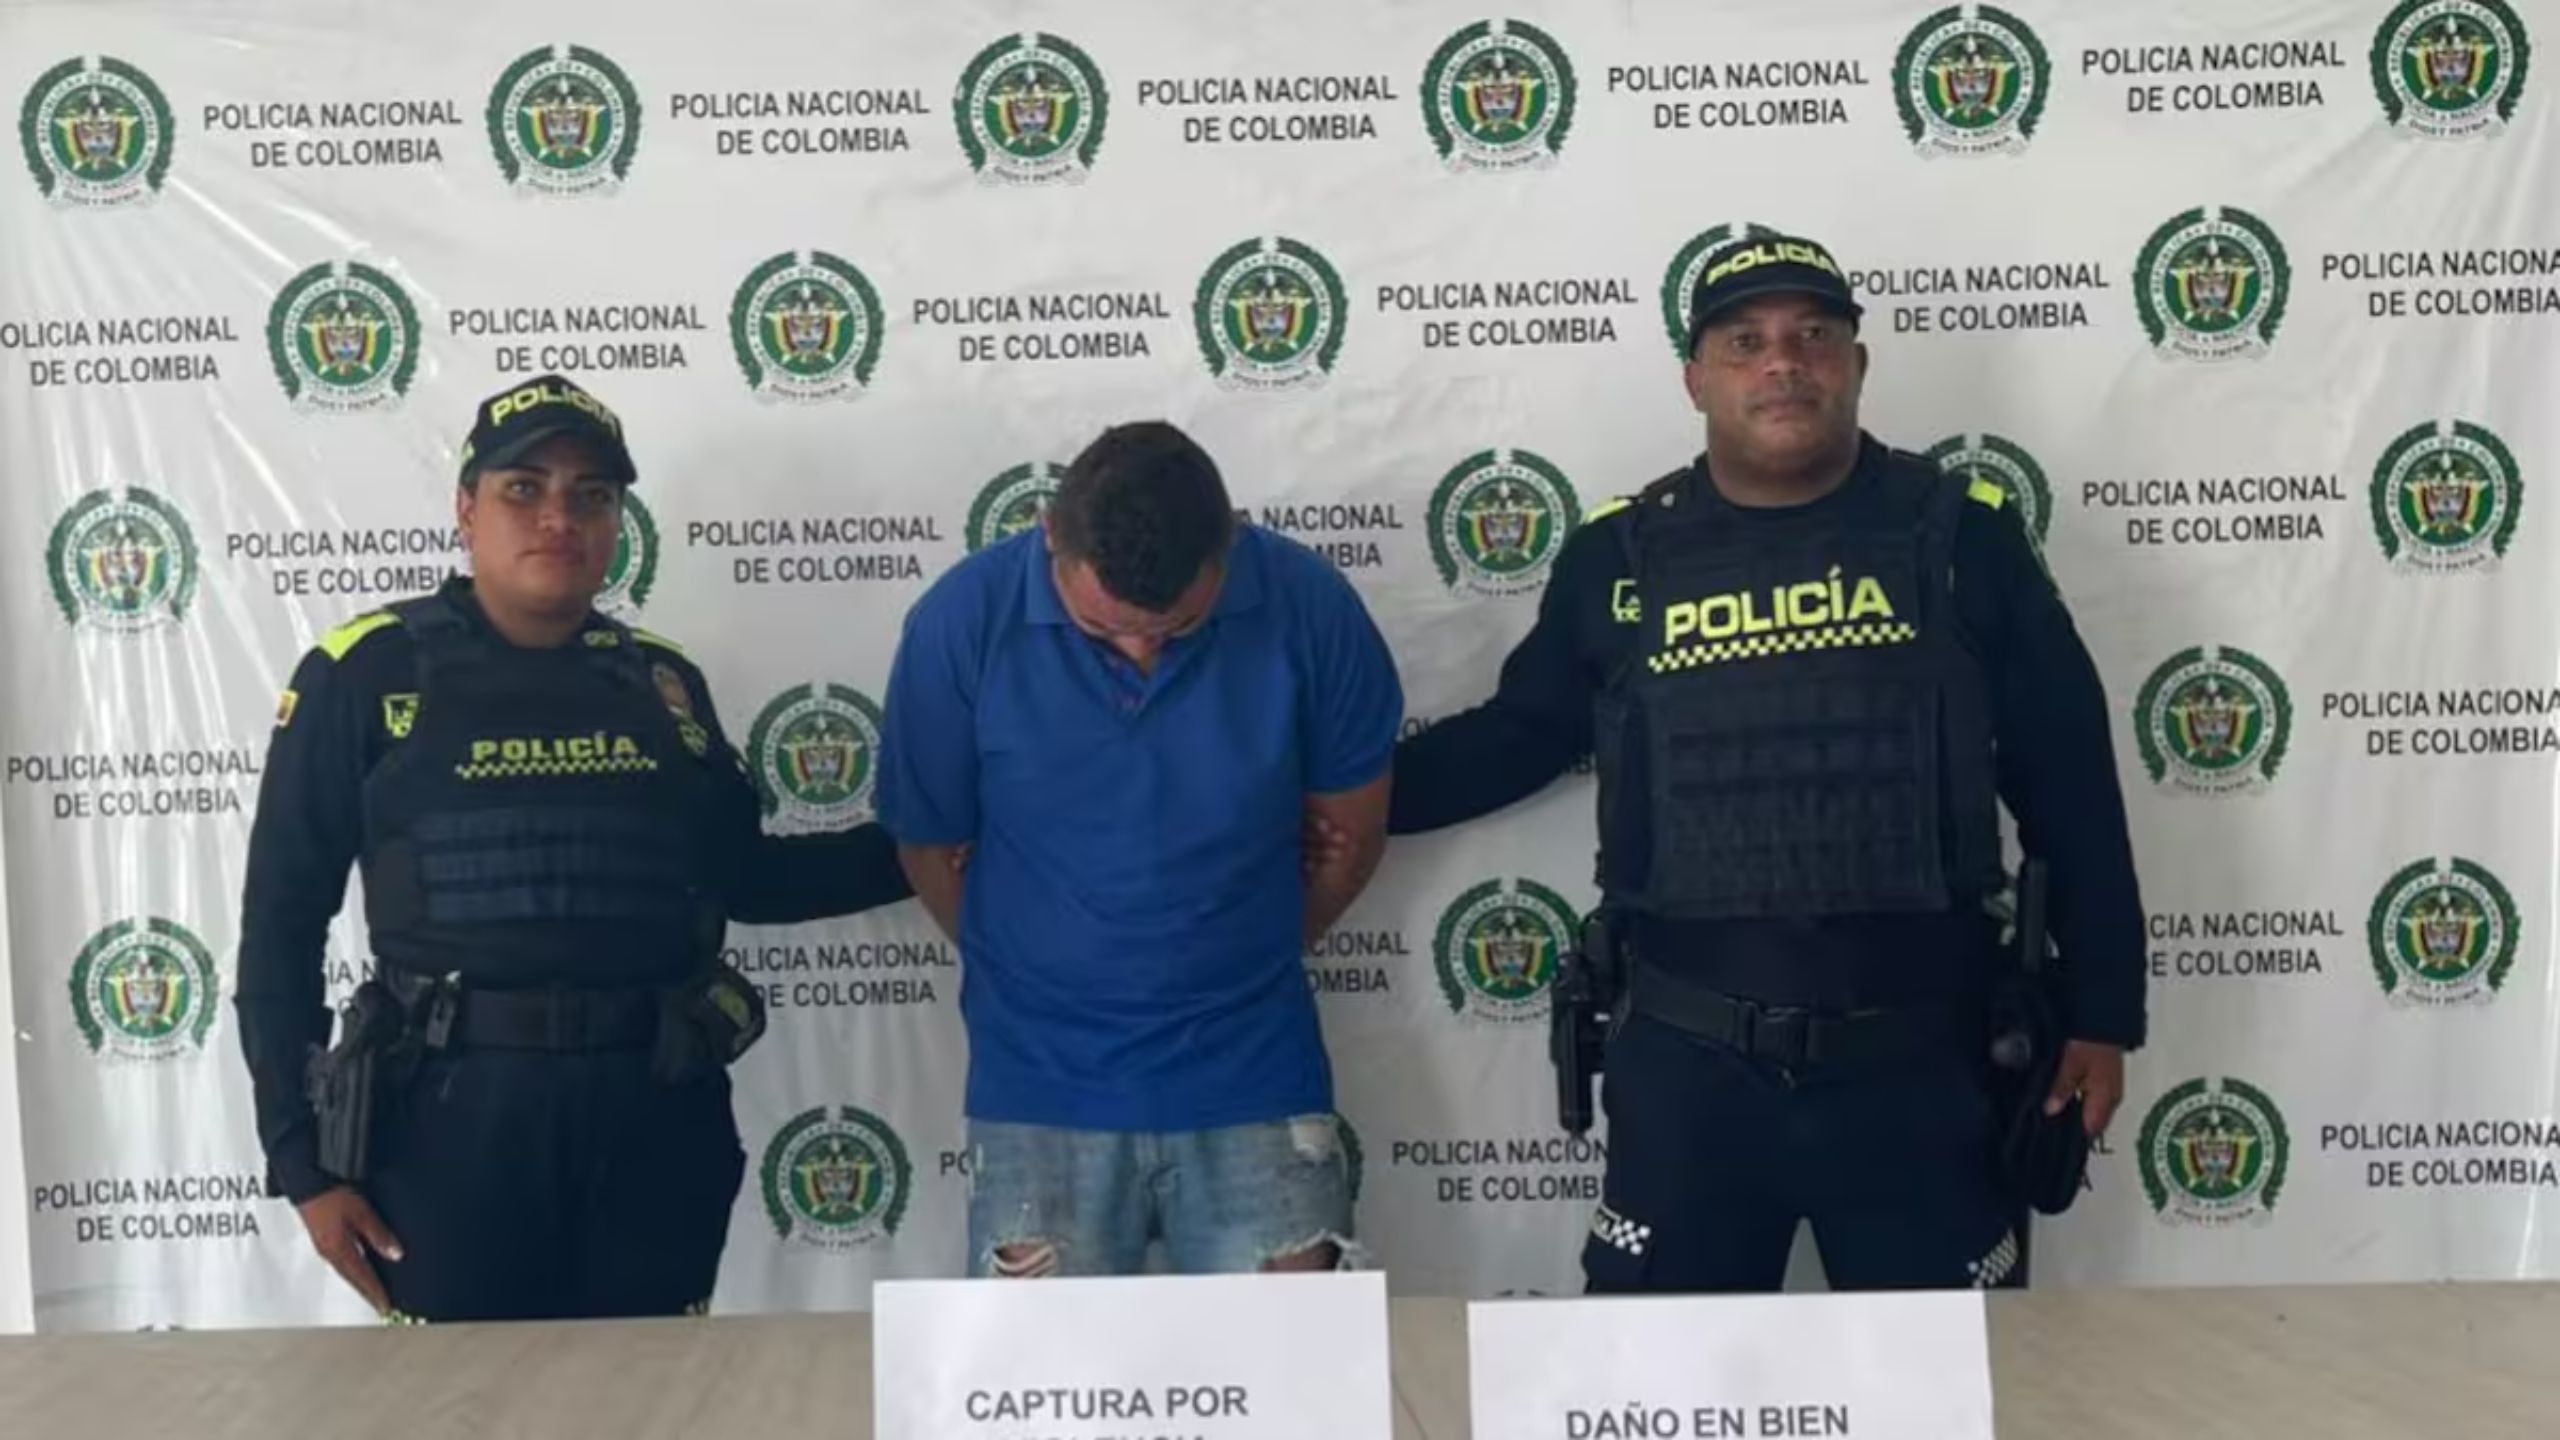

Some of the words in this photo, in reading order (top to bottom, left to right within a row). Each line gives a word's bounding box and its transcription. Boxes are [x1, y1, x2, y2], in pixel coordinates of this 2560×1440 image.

[2082, 46, 2193, 75] POLICIA
[2201, 41, 2346, 71] NACIONAL
[1138, 78, 1248, 106] POLICIA
[1255, 76, 1398, 103] NACIONAL
[1608, 64, 1719, 92] POLICIA
[1725, 60, 1869, 89] NACIONAL
[671, 92, 780, 119] POLICIA
[787, 89, 930, 117] NACIONAL
[2128, 85, 2164, 113] DE
[2172, 80, 2324, 111] COLOMBIA
[204, 104, 314, 130] POLICIA
[320, 100, 462, 128] NACIONAL
[1184, 116, 1221, 143] DE
[1229, 113, 1377, 142] COLOMBIA
[1654, 102, 1691, 129] DE
[1699, 98, 1848, 128] COLOMBIA
[251, 141, 288, 167] DE
[296, 138, 443, 166] COLOMBIA
[717, 129, 753, 155] DE
[761, 127, 909, 154] COLOMBIA
[1849, 268, 1959, 295] POLICIA
[1966, 263, 2110, 292] NACIONAL
[2322, 251, 2435, 280] POLICIA
[2442, 249, 2560, 277] NACIONA
[913, 296, 1022, 324] POLICIA
[1029, 293, 1170, 321] NACIONAL
[1378, 283, 1488, 311] POLICIA
[1495, 278, 1638, 307] NACIONAL
[2369, 290, 2406, 317] DE
[2415, 286, 2560, 316] COLOMBIA
[0, 321, 91, 348] OLICIA
[98, 317, 238, 345] NACIONAL
[449, 308, 559, 335] POLICIA
[565, 305, 706, 332] NACIONAL
[1424, 321, 1460, 348] DE
[1468, 316, 1617, 346] COLOMBIA
[1894, 307, 1930, 333] DE
[1939, 301, 2088, 331] COLOMBIA
[496, 346, 533, 372] DE
[540, 343, 687, 372] COLOMBIA
[960, 335, 996, 362] DE
[1003, 331, 1150, 361] COLOMBIA
[30, 360, 66, 386] DE
[74, 354, 219, 384] COLOMBIA
[2083, 480, 2191, 507] POLICIA
[2198, 474, 2346, 505] NACIONAL
[688, 520, 795, 546] POLICIA
[803, 517, 942, 544] NACIONAL
[1263, 504, 1403, 531] NACIONAL
[2128, 518, 2163, 544] DE
[2172, 513, 2324, 543] COLOMBIA
[226, 530, 336, 559] POLICIA
[342, 527, 465, 556] NACIONA
[273, 569, 310, 596] DE
[734, 558, 769, 583] DE
[778, 555, 922, 582] COLOMBIA
[1664, 564, 1895, 647] POLICÍA
[2323, 691, 2430, 718] POLICIA
[2438, 688, 2560, 716] NACIONA
[471, 730, 638, 761] POLICÍA
[2367, 729, 2403, 756] DE
[2411, 726, 2560, 754] COLOMBIA
[8, 754, 116, 783] POLICIA
[122, 748, 259, 781] NACIONAL
[54, 793, 90, 818] DE
[98, 786, 241, 817] COLOMBIA
[2203, 911, 2344, 938] NACIONAL
[722, 946, 812, 973] OLICIA
[818, 943, 956, 970] NACIONAL
[2151, 951, 2168, 977] E
[2176, 948, 2322, 976] COLOMBIA
[793, 980, 936, 1007] COLOMBIA
[1304, 968, 1389, 993] OMBIA
[2321, 1123, 2430, 1150] POLICIA
[2436, 1121, 2560, 1149] NACIONA
[1394, 1141, 1500, 1165] POLICIA
[1507, 1138, 1608, 1164] NACION
[1438, 1177, 1472, 1201] DE
[1482, 1175, 1599, 1201] COLOMB
[2368, 1161, 2404, 1187] DE
[2412, 1158, 2558, 1187] COLOMBIA
[34, 1179, 138, 1211] POLICIA
[144, 1174, 262, 1203] NACIONA
[77, 1216, 114, 1242] DE
[122, 1210, 260, 1240] COLOMBIA
[966, 1387, 1154, 1421] CAPTURA
[1166, 1386, 1249, 1419] POR
[1566, 1401, 1680, 1440] DAÑO
[1693, 1407, 1746, 1440] EN
[1759, 1405, 1849, 1439] BIEN
